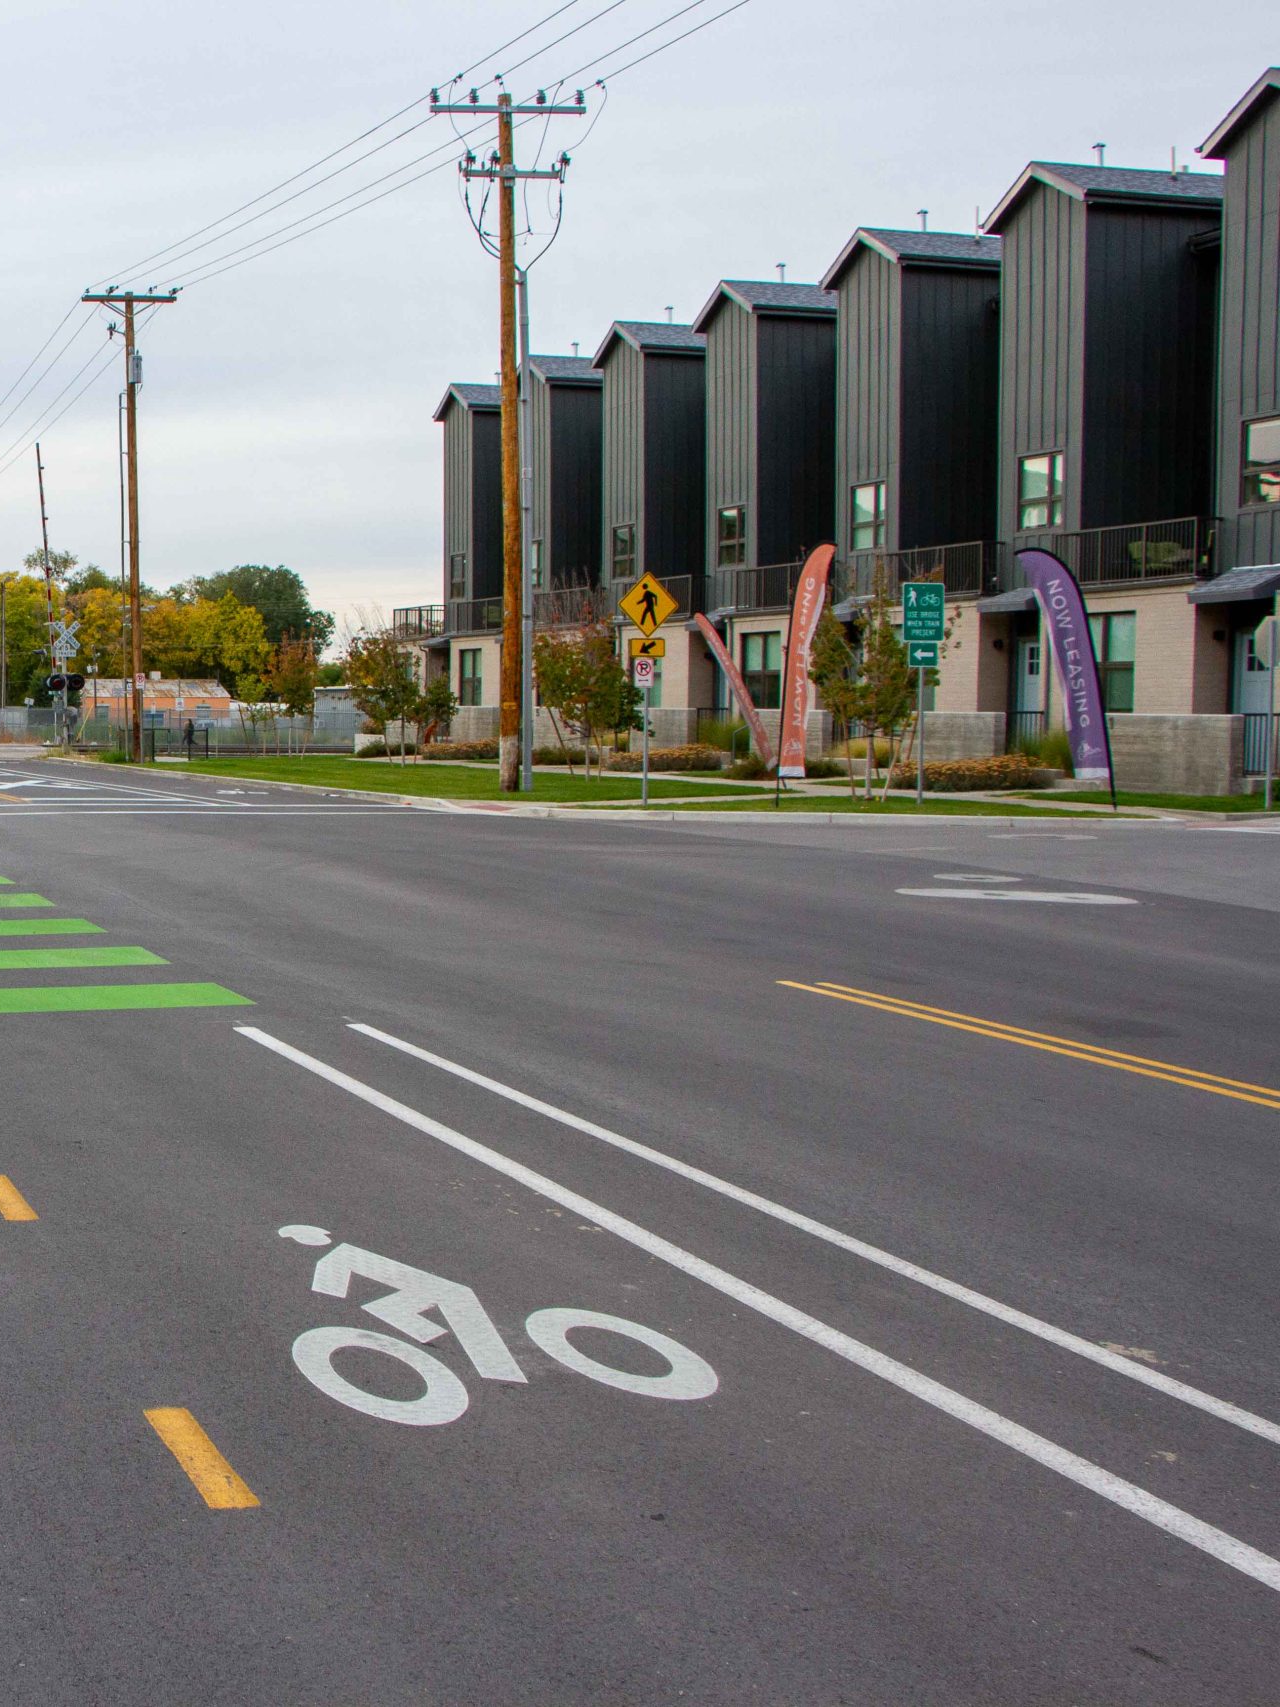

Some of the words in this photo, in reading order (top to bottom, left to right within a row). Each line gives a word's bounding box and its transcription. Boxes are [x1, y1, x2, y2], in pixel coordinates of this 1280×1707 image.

[793, 678, 805, 726] NOW
[1047, 579, 1073, 628] NOW
[1063, 637, 1091, 728] LEASING
